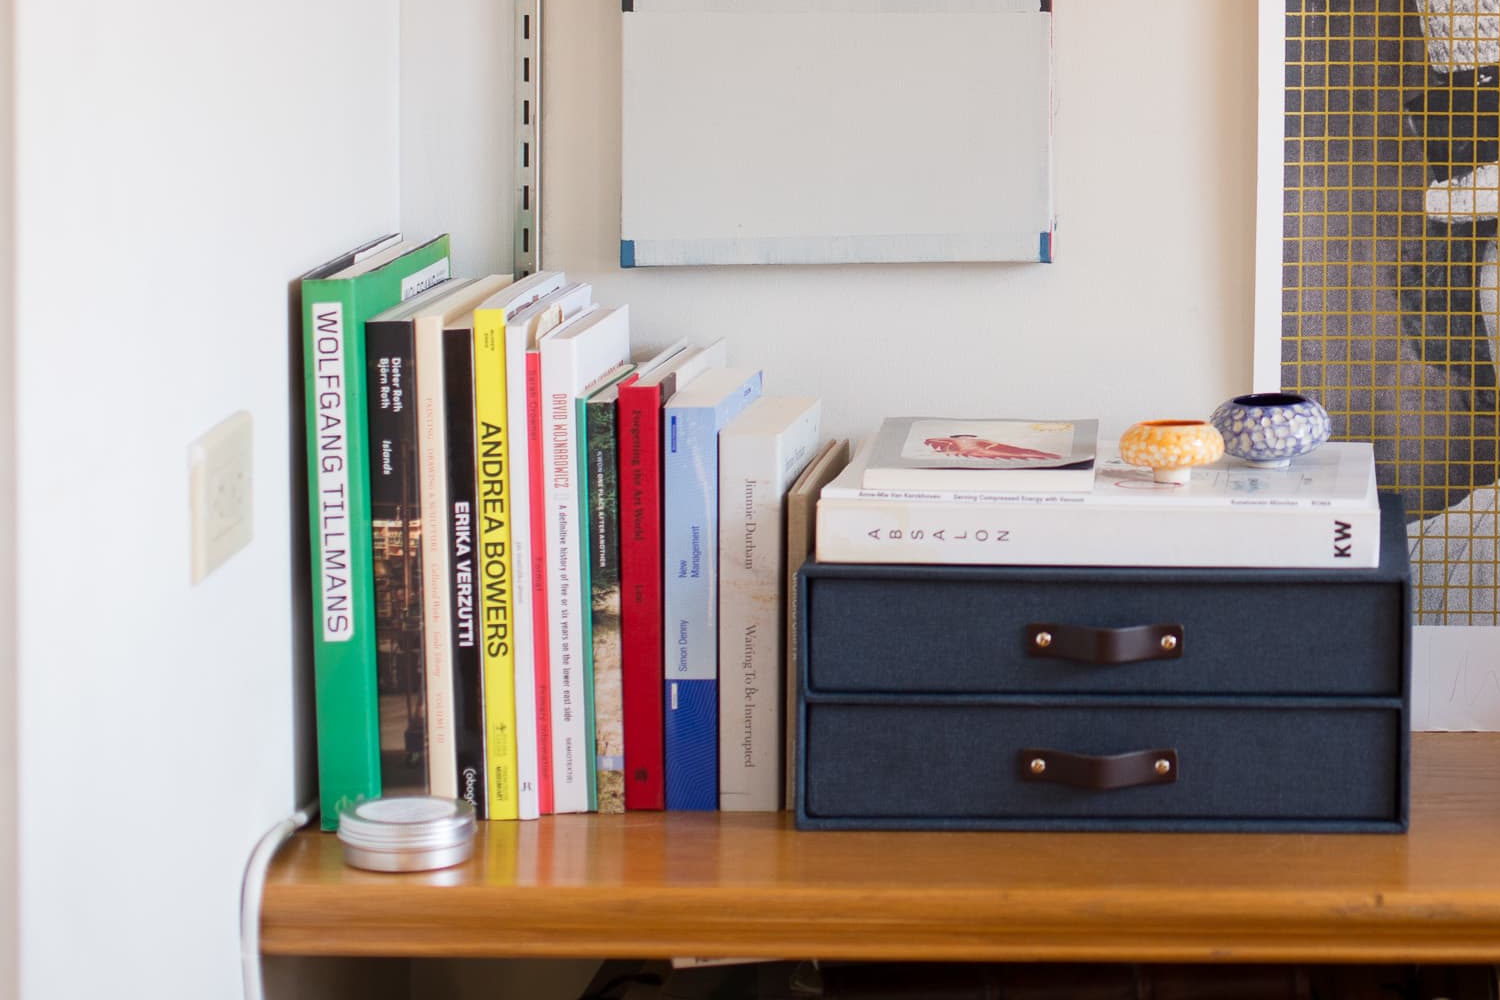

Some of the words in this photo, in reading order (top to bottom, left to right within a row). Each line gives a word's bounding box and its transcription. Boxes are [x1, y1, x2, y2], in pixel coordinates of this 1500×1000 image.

[379, 357, 391, 384] Björn
[391, 356, 402, 388] Dieter
[315, 311, 344, 474] WOLFGANG
[380, 386, 391, 409] Roth
[392, 389, 404, 413] Roth
[551, 393, 569, 420] DAVID
[382, 439, 393, 476] Islands
[552, 424, 570, 489] WOJNAROWICZ
[480, 421, 505, 535] ANDREA
[633, 469, 644, 487] the
[633, 490, 644, 507] Art
[744, 478, 757, 520] Jimmie
[454, 501, 471, 556] ERIKA
[558, 512, 568, 545] definitive
[598, 511, 606, 533] AFTER
[634, 509, 645, 541] World
[868, 528, 1011, 542] ABSALON
[598, 534, 607, 568] ANOTHER
[677, 559, 687, 579] New
[689, 525, 701, 579] Management
[744, 522, 757, 570] Durham
[1333, 520, 1352, 558] KW
[322, 483, 351, 635] TILLMANS
[556, 547, 569, 571] history
[456, 559, 474, 647] VERZUTTI
[484, 542, 509, 658] BOWERS
[560, 583, 570, 597] five
[559, 621, 570, 640] years
[678, 619, 689, 645] Denny
[562, 653, 572, 666] the
[742, 624, 757, 668] Waiting
[679, 647, 689, 673] Simon
[562, 667, 572, 687] lower
[744, 671, 757, 685] To
[563, 690, 572, 705] east
[744, 687, 758, 701] Be
[563, 707, 573, 723] side
[743, 704, 757, 768] Interrupted
